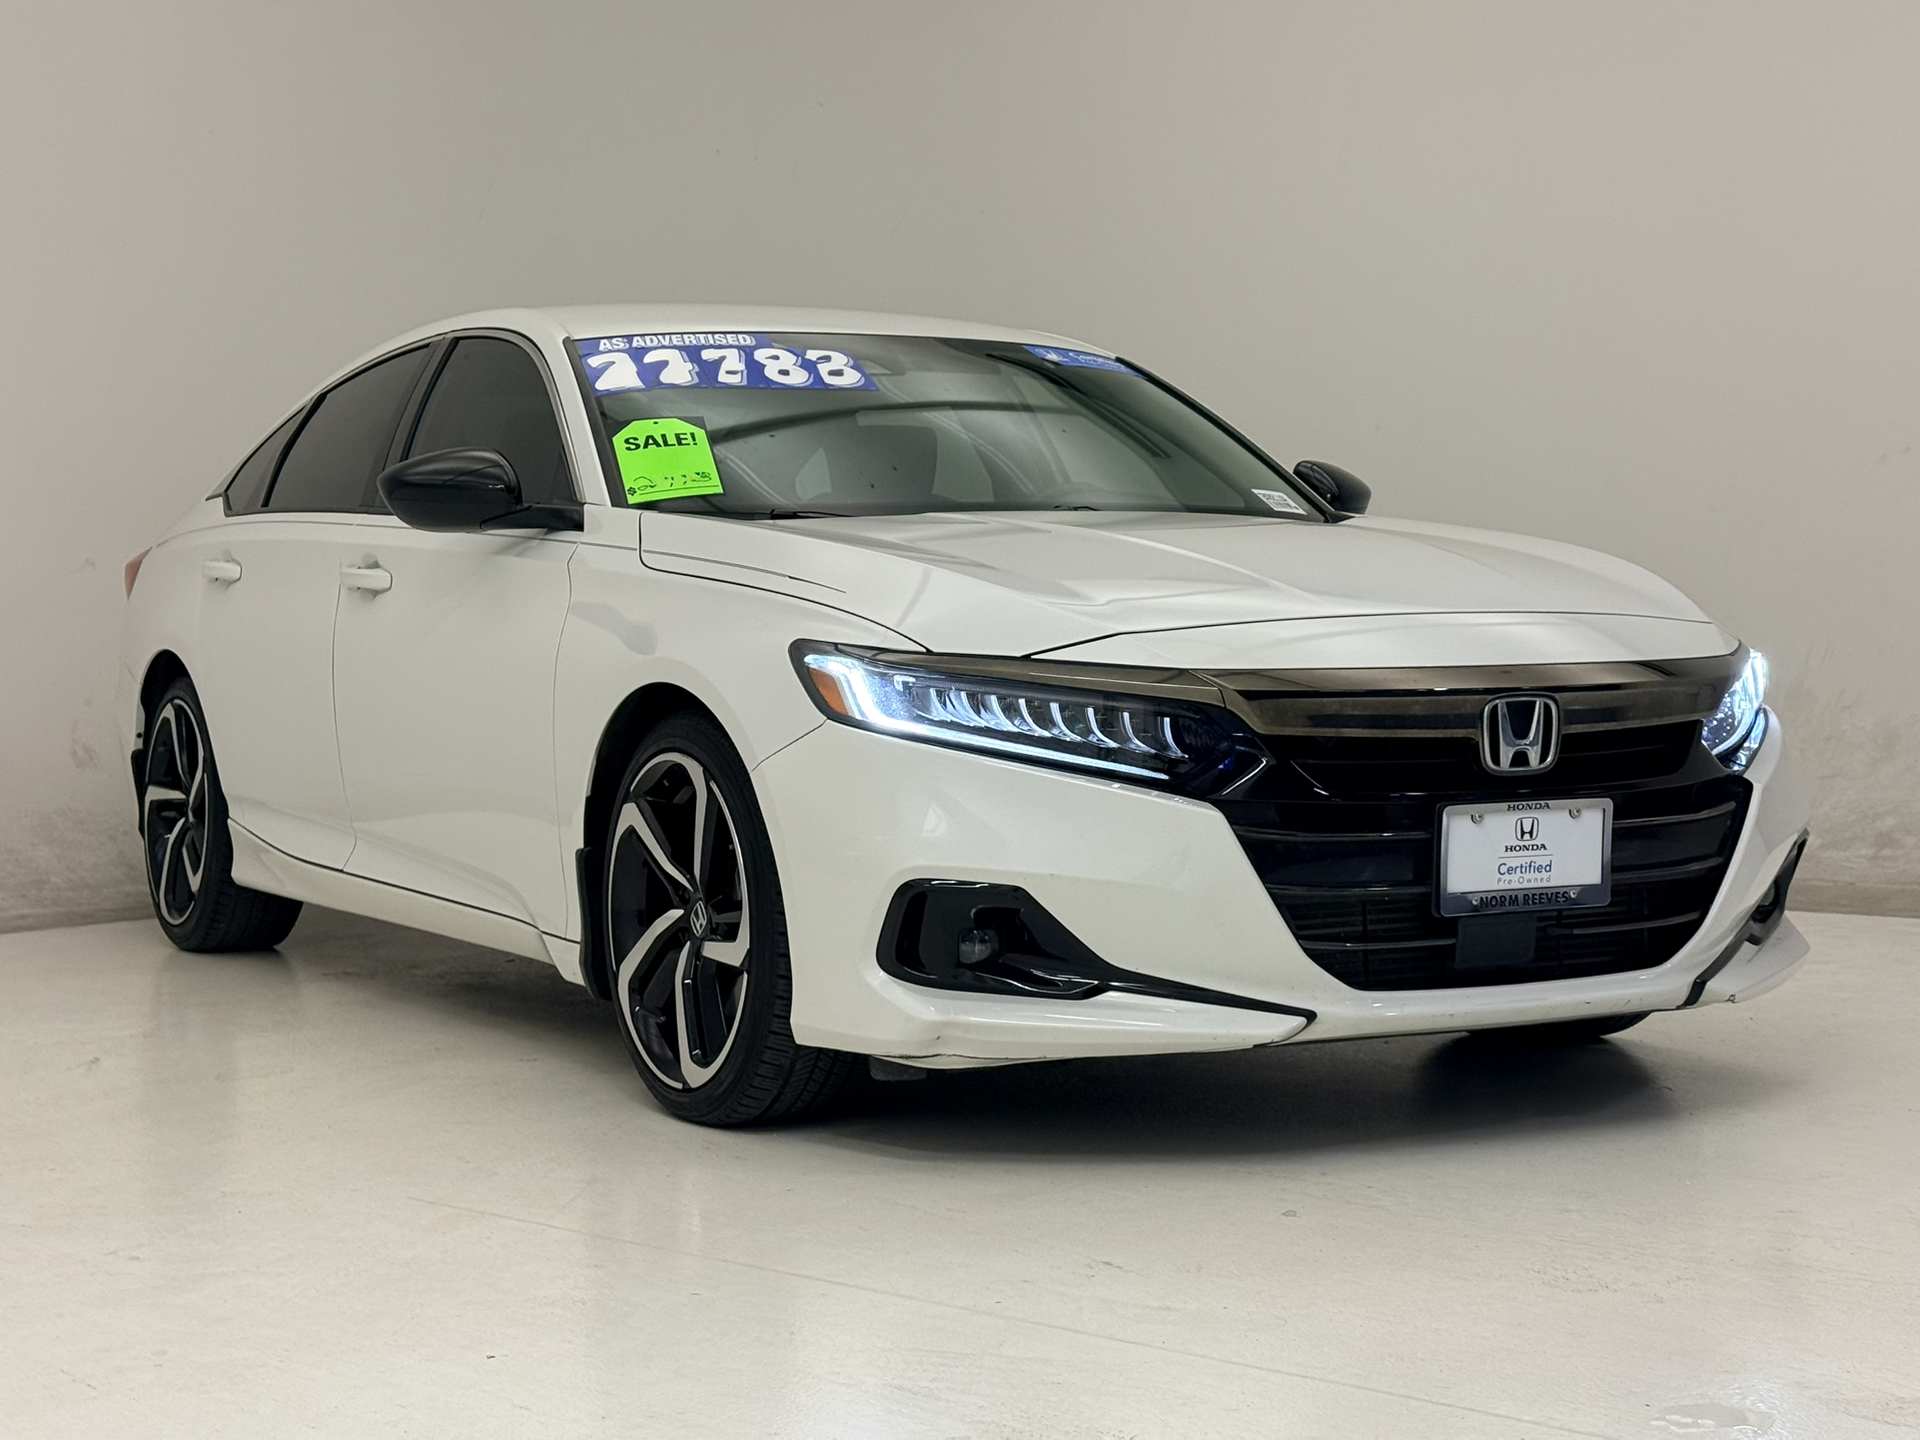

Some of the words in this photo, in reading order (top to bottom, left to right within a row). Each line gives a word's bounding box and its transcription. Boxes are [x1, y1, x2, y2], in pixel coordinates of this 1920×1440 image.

[598, 337, 630, 351] AS
[631, 333, 757, 349] ADVERTISED
[623, 432, 698, 452] SALE!
[1506, 801, 1551, 812] HONDA
[1504, 843, 1548, 853] HONDA
[1497, 859, 1552, 876] Certified
[1496, 875, 1552, 886] Pre-Owned
[1479, 893, 1520, 909] NORM
[1522, 890, 1569, 906] REEVES
